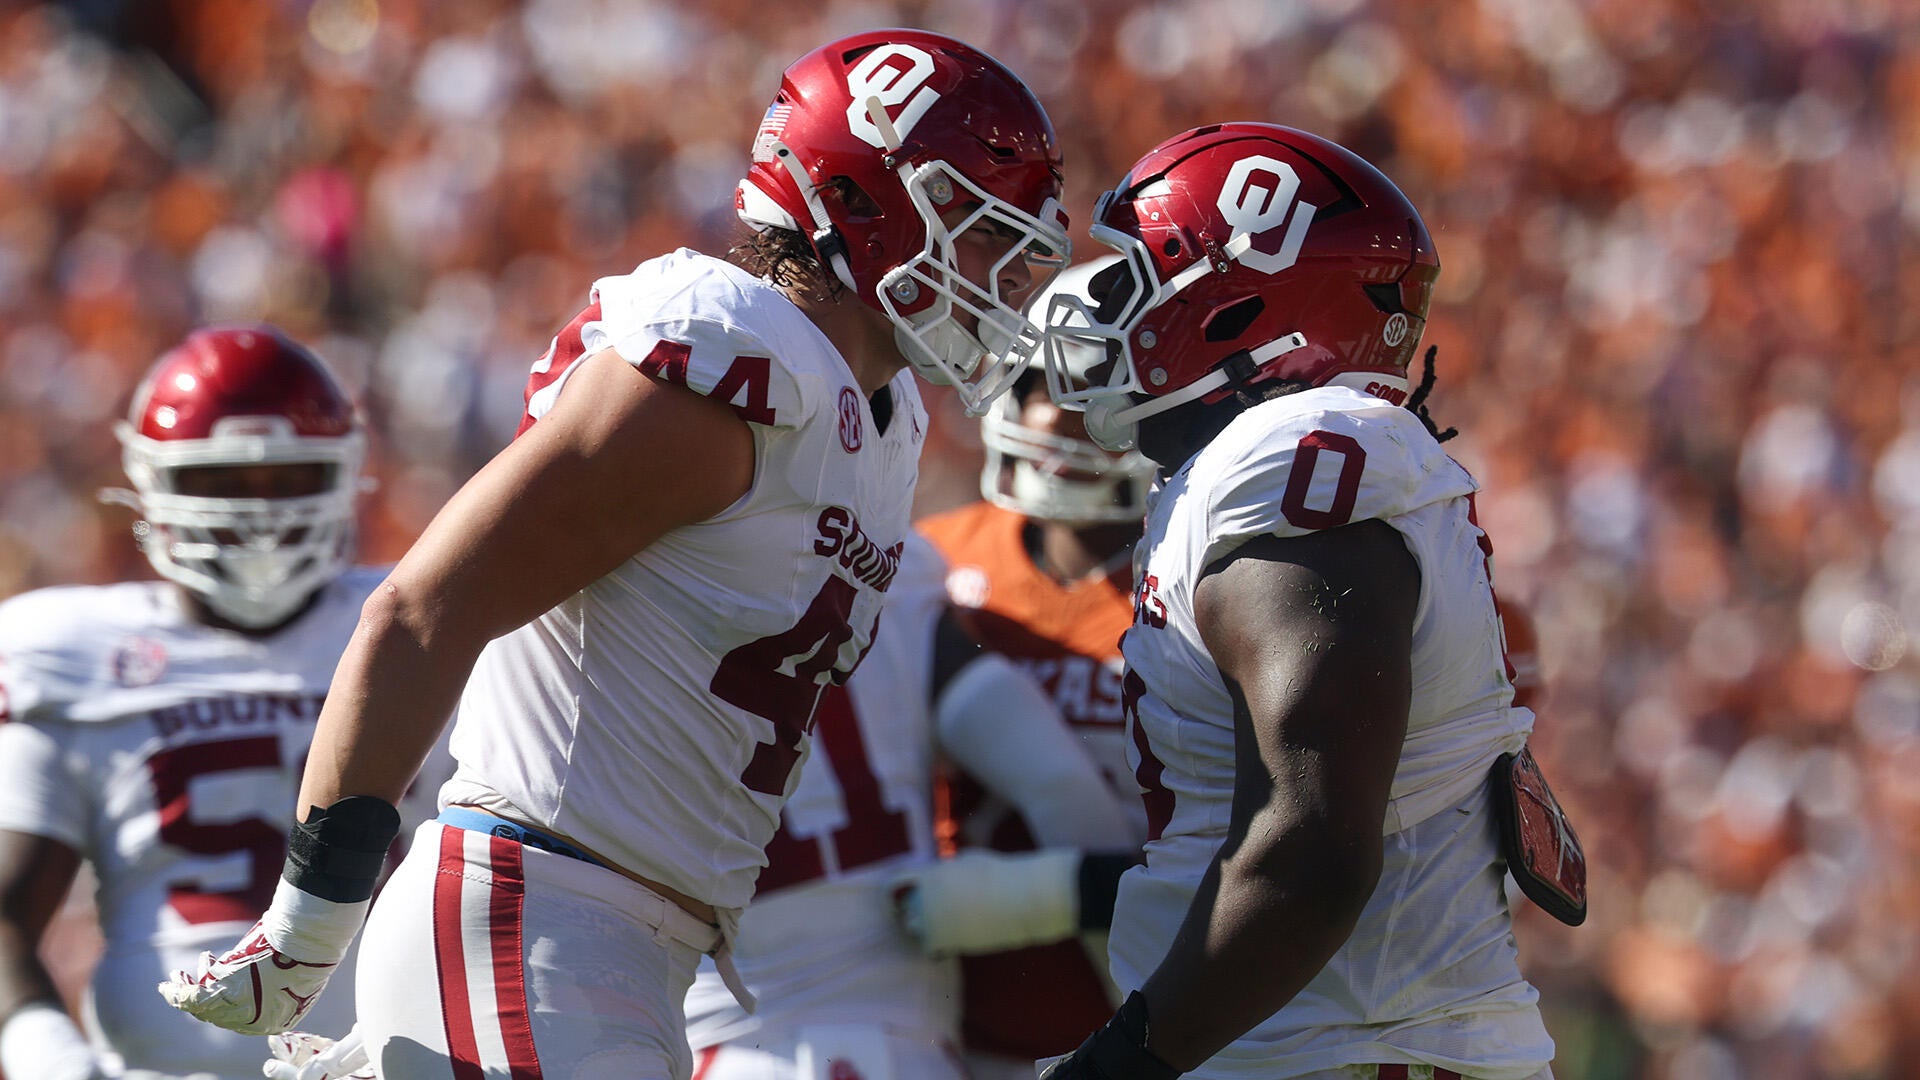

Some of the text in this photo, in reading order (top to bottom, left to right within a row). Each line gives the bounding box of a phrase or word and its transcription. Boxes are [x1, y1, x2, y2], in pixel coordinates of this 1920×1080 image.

[845, 43, 941, 149] OU
[1216, 154, 1318, 275] OU
[1384, 313, 1408, 347] SEC
[1280, 429, 1367, 531] 0
[814, 506, 904, 593] SOON
[147, 734, 345, 926] 5
